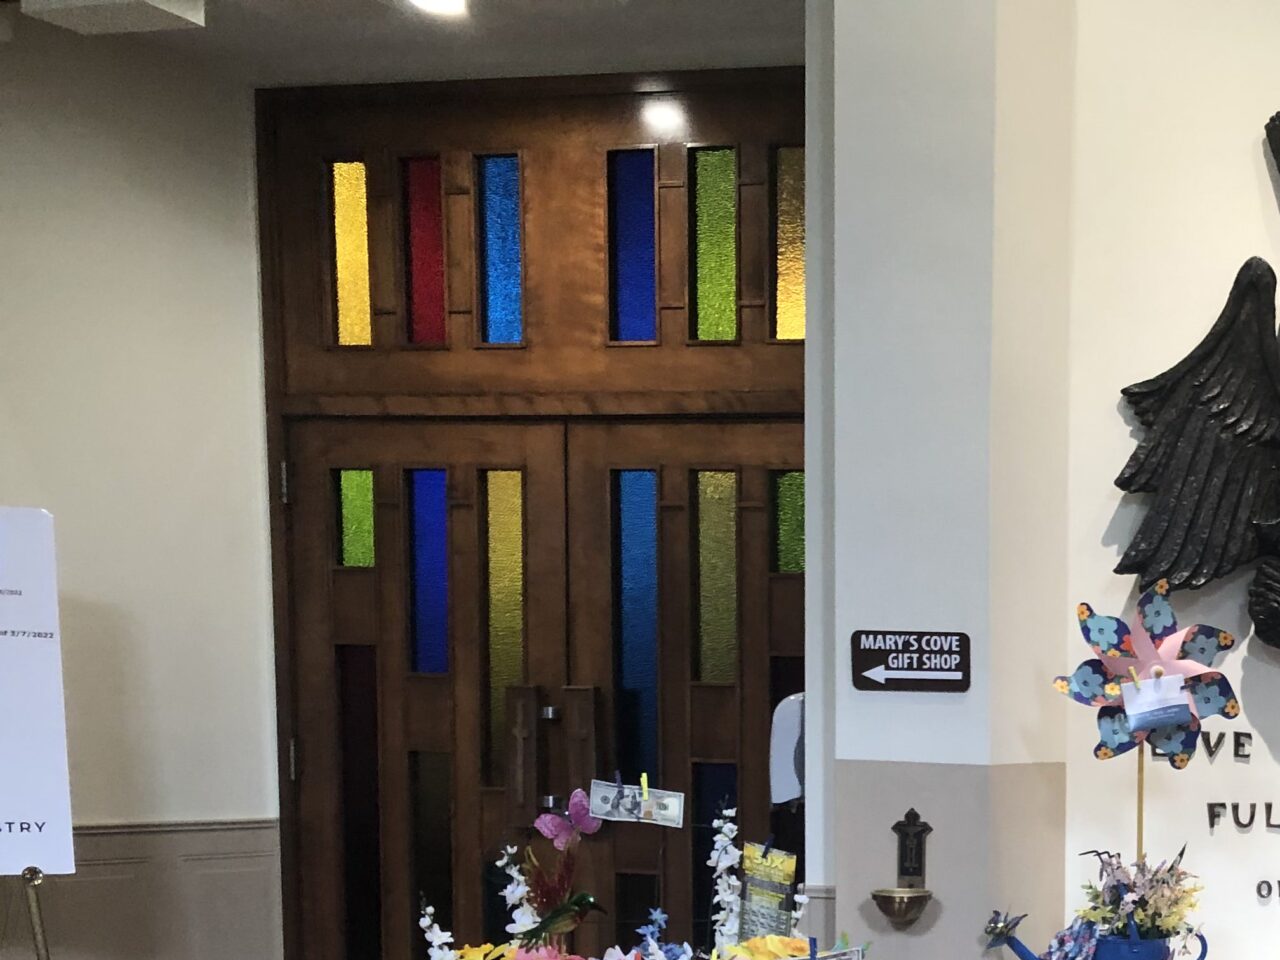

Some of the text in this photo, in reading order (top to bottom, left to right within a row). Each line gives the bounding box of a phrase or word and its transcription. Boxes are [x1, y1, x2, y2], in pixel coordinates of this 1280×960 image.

[860, 634, 960, 651] MARY'S COVE
[888, 653, 961, 669] GIFT SHOP
[0, 821, 46, 833] TRY
